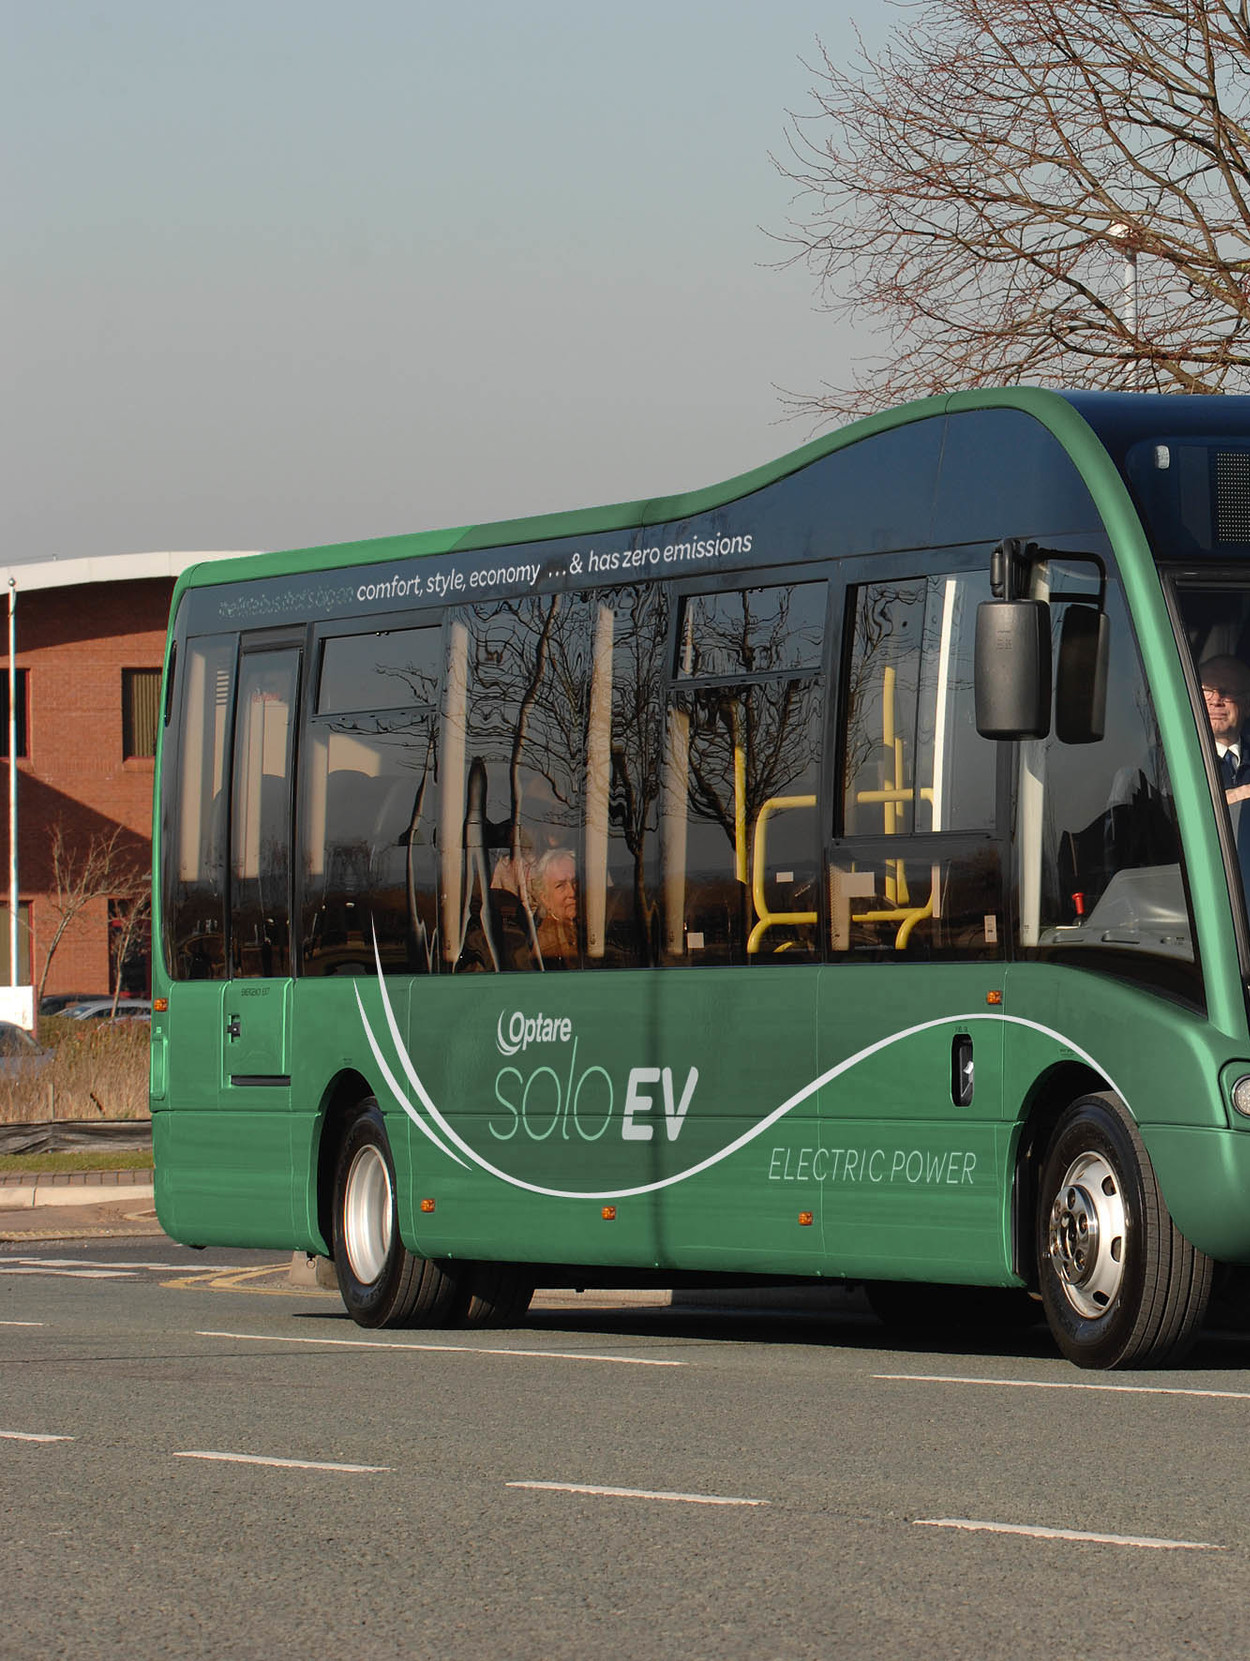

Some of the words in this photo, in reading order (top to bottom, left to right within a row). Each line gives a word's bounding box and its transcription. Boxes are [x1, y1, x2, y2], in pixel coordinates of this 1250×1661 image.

[356, 574, 424, 601] comfort,
[426, 567, 467, 597] style,
[469, 563, 542, 586] economy
[588, 549, 620, 572] has
[622, 546, 660, 567] zero
[663, 531, 753, 562] emissions
[507, 1011, 572, 1051] Optare
[488, 1036, 614, 1141] solo
[621, 1066, 699, 1142] EV
[768, 1147, 885, 1182] ELECTRIC
[890, 1150, 977, 1184] POWER
